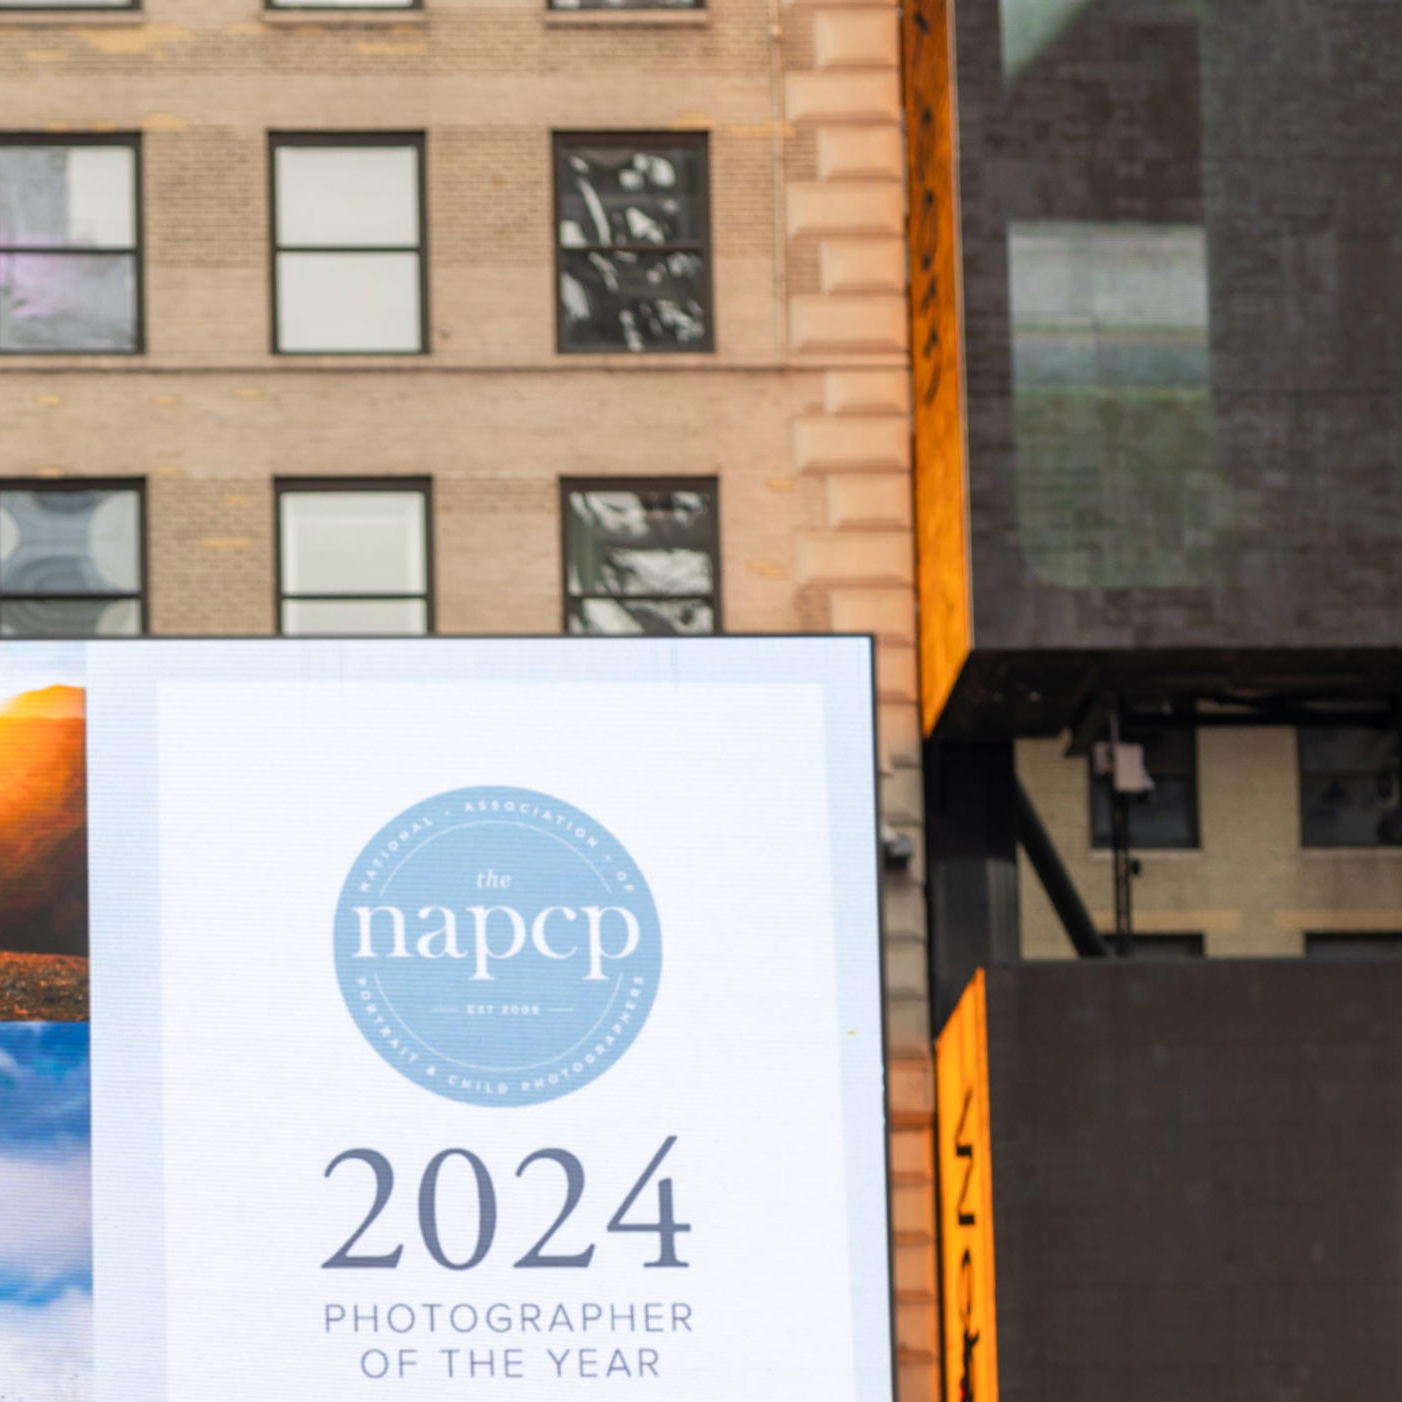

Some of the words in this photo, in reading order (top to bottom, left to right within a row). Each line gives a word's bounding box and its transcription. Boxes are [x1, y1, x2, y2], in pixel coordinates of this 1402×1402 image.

[359, 815, 433, 893] NATIONAL
[464, 800, 598, 847] ASSOCIATION
[616, 870, 635, 892] OF
[476, 869, 512, 889] the
[351, 905, 641, 981] napcp
[356, 976, 420, 1063] PORTRAIT
[448, 1074, 509, 1094] CHILD
[521, 975, 645, 1092] PHOTOGRAPHERS
[467, 1004, 494, 1016] EST
[320, 1135, 692, 1271] 2024
[324, 1302, 693, 1334] PHOTOGRAPHER
[360, 1348, 418, 1379] OF
[440, 1348, 524, 1379] THE
[546, 1348, 660, 1379] YEAR
